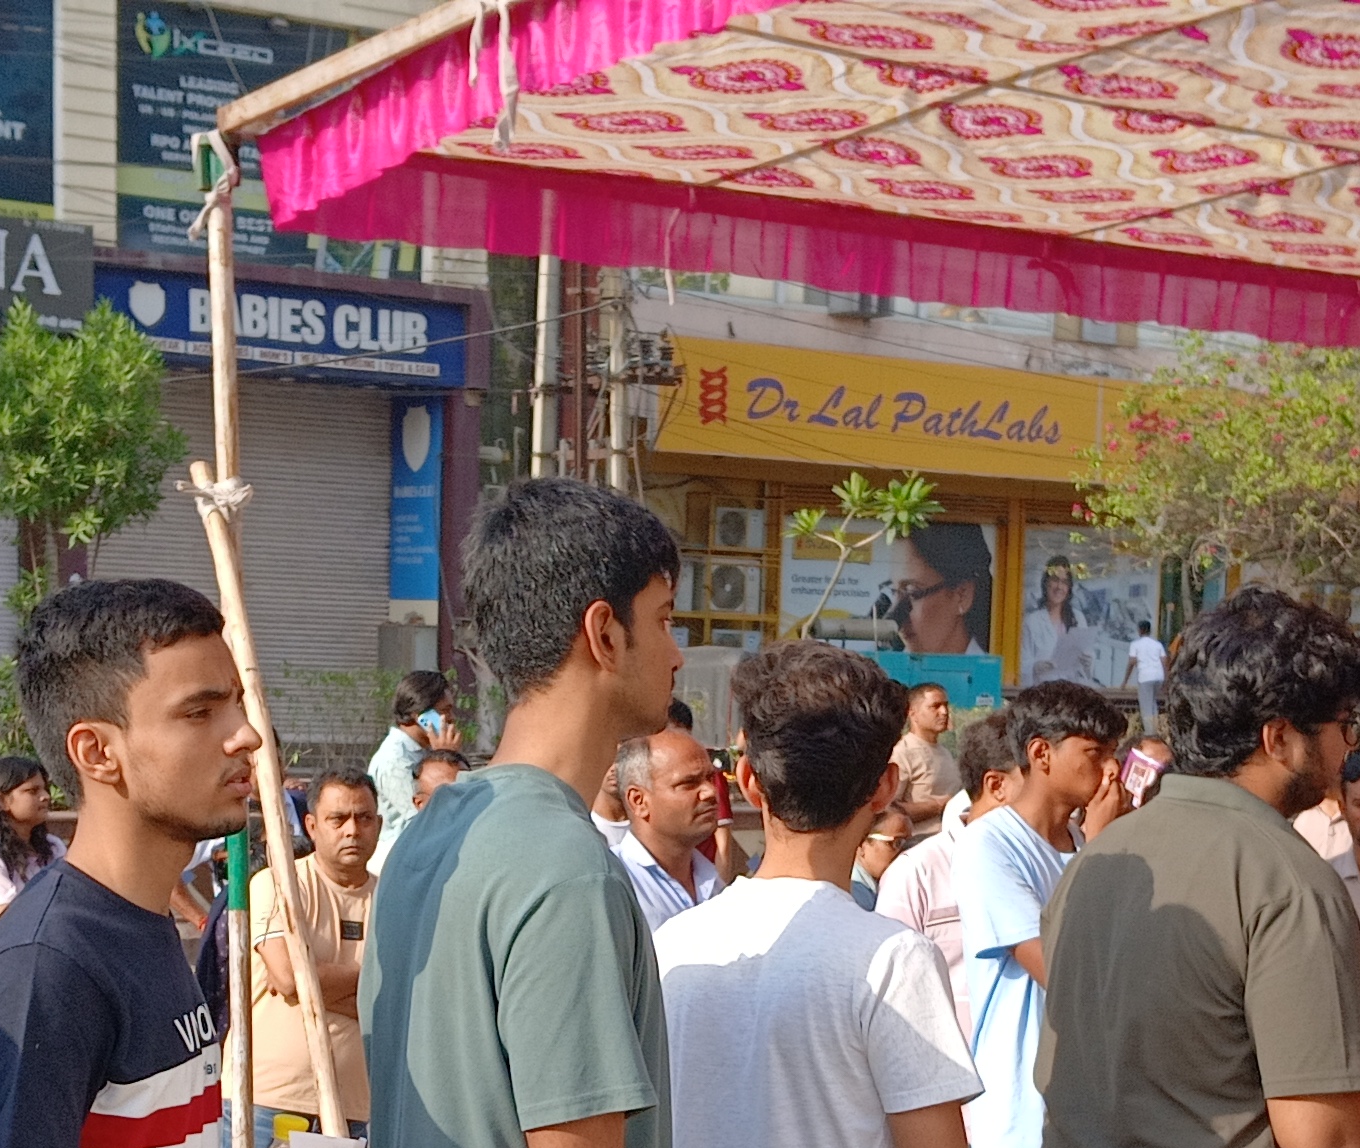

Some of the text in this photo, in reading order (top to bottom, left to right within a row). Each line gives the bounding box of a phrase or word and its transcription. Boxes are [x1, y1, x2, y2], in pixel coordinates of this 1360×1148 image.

[132, 84, 184, 104] TALENT
[189, 287, 428, 354] BBIES CLUB
[745, 376, 1062, 446] Dr Lal PathLabs
